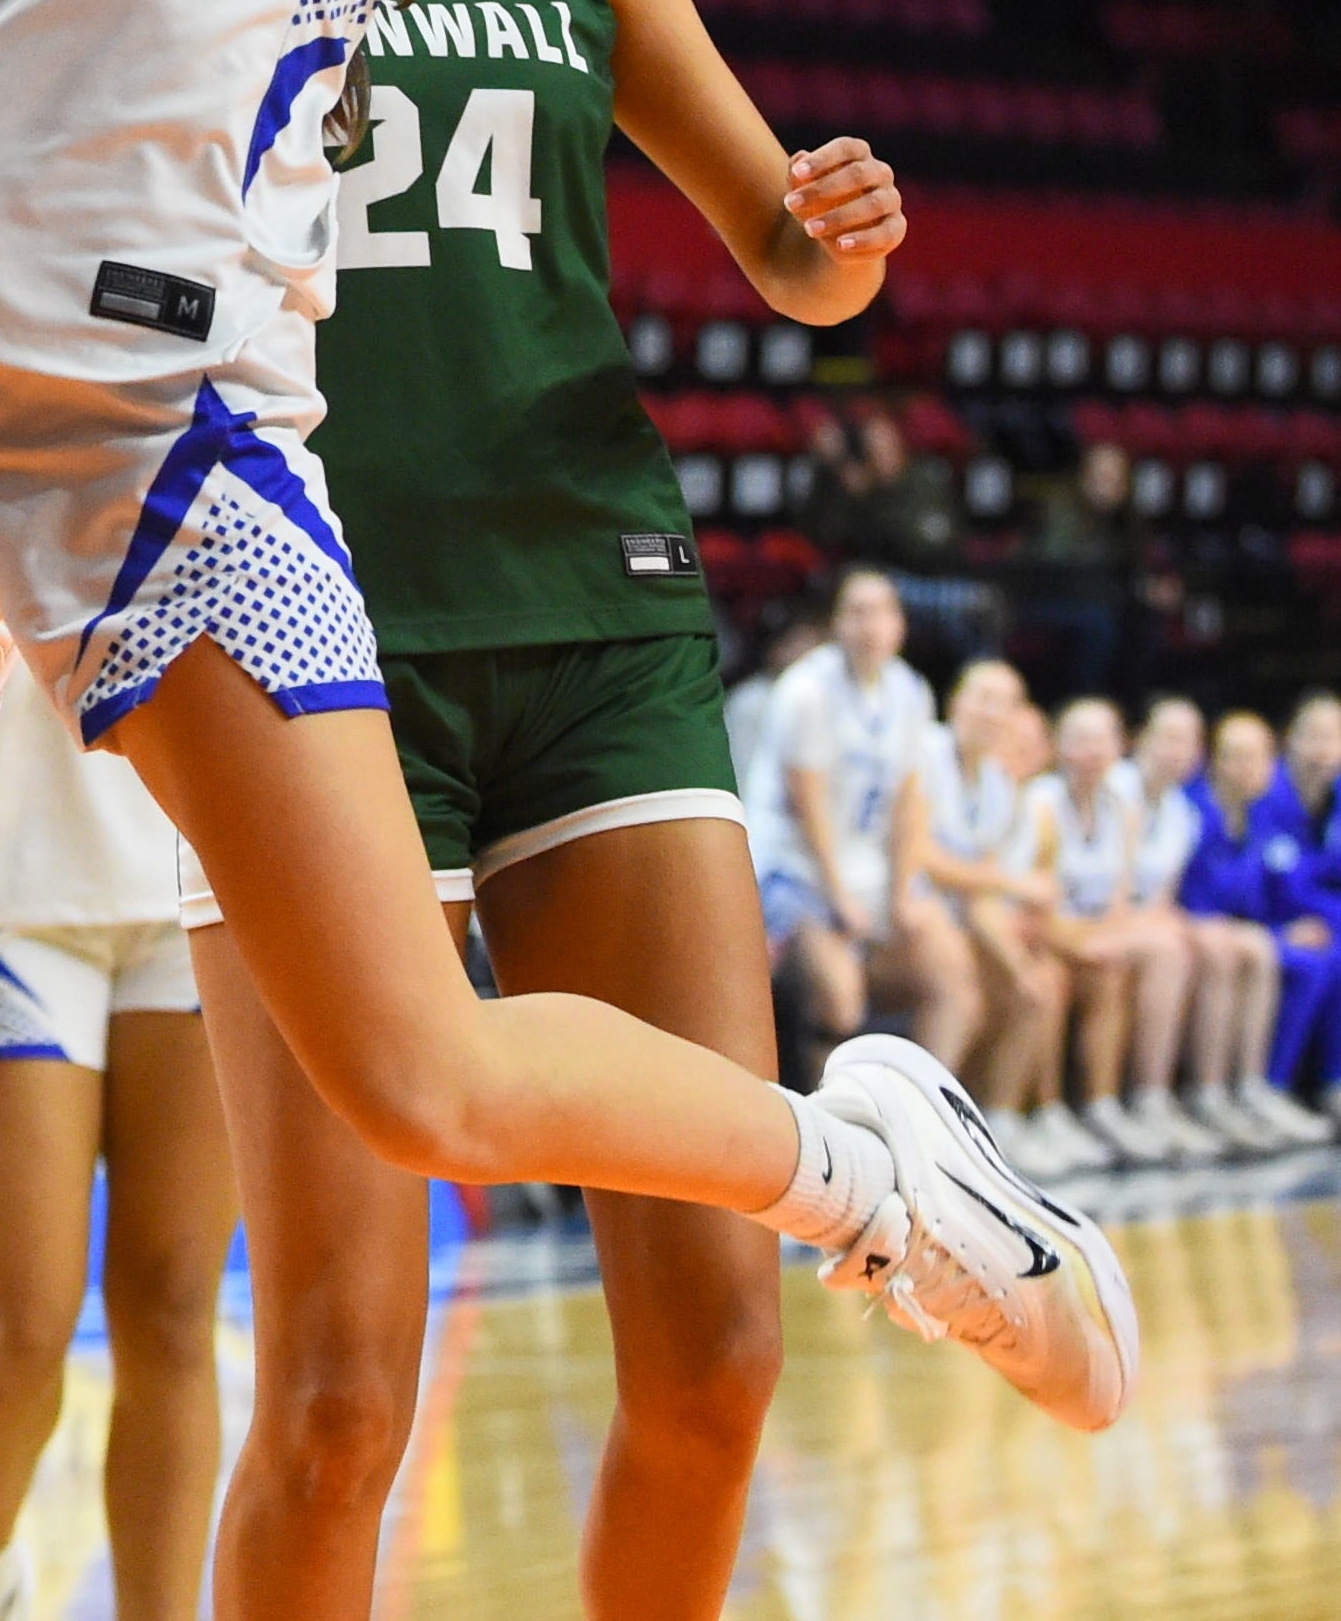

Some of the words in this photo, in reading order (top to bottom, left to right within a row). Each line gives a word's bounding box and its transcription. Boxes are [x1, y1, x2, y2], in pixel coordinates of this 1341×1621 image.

[326, 84, 542, 271] 24
[177, 294, 200, 321] M
[678, 545, 691, 564] L
